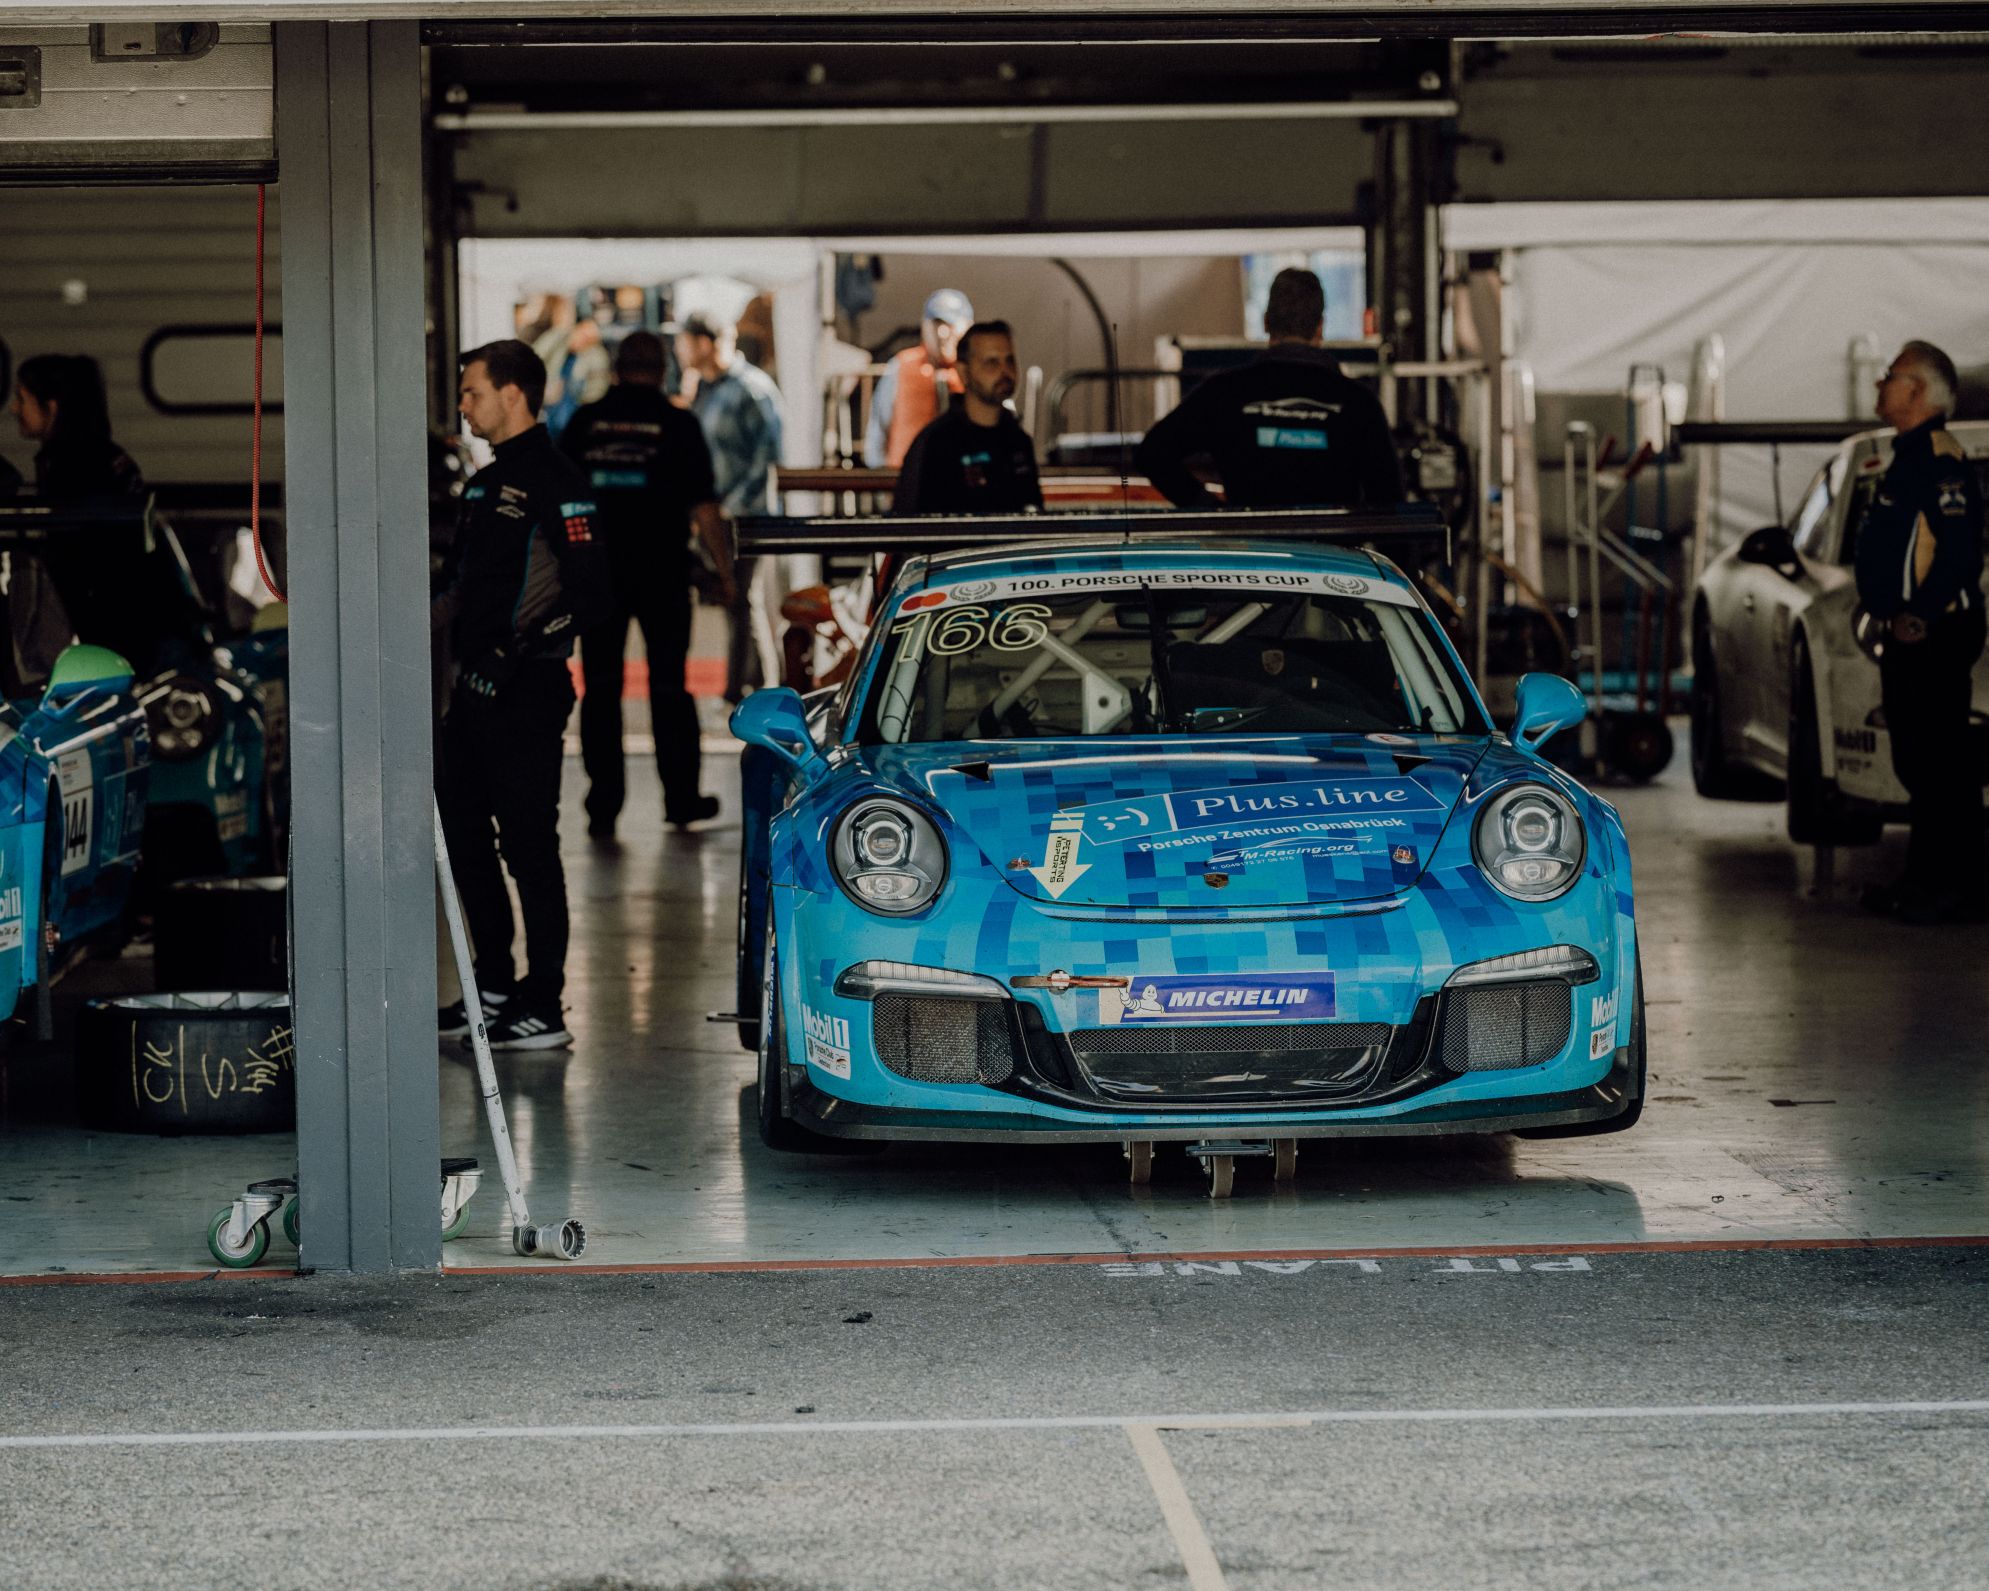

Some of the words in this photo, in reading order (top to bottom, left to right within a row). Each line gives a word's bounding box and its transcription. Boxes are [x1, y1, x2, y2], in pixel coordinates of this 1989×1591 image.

[1007, 580, 1056, 592] 100.
[1061, 575, 1166, 588] PORSCHE
[1172, 574, 1264, 584] SPORTS
[1266, 575, 1309, 586] CUP
[891, 603, 1053, 662] 166
[1191, 787, 1409, 817] Plus.line
[64, 797, 87, 861] 144
[1137, 834, 1218, 852] Porsche
[1217, 825, 1302, 840] Zentrum
[1303, 818, 1407, 831] Osnabrück
[1168, 988, 1309, 1008] MICHELIN
[802, 1003, 833, 1047] Mobil
[1099, 1259, 1383, 1277] LANE
[1432, 1256, 1592, 1273] PIT
